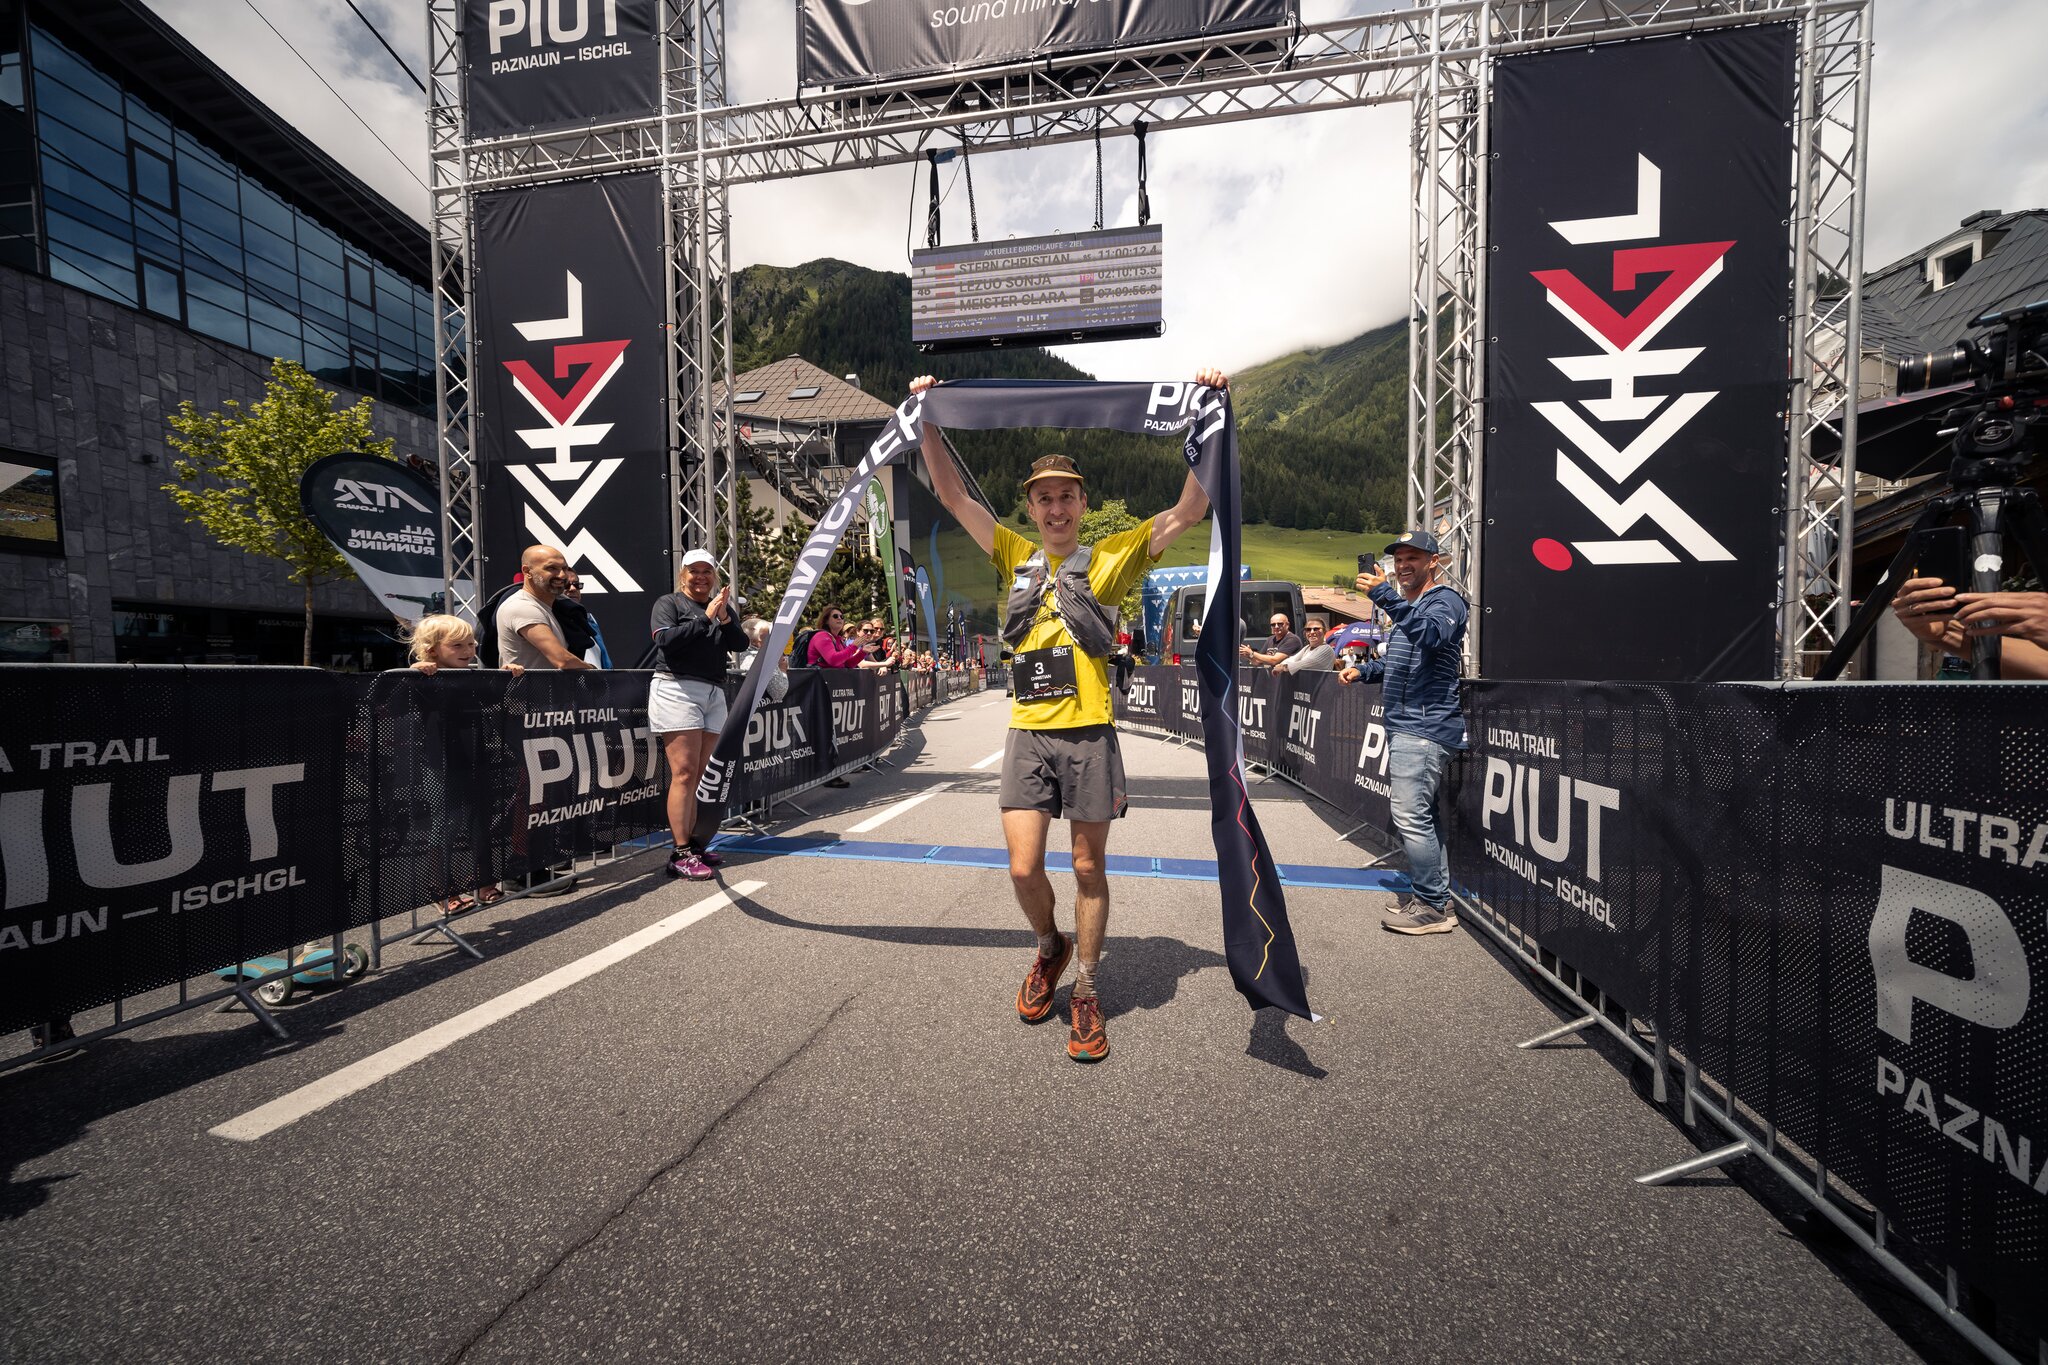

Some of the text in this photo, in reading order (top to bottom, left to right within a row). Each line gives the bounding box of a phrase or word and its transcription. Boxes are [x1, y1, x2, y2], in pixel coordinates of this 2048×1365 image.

[488, 0, 618, 55] PIUT
[930, 0, 1006, 28] sound
[491, 51, 561, 75] PAZNAUN
[578, 42, 632, 62] ISCHGL
[959, 259, 999, 273] STERN
[1002, 252, 1070, 269] CHRISTIAN
[1098, 244, 1158, 260] 11:00:124
[983, 246, 1018, 256] AKTUELLE
[1069, 240, 1084, 248] ZIEL
[959, 277, 1002, 293] LEZUO
[1005, 272, 1052, 289] SONJA
[959, 295, 1018, 312] MEISTER
[1021, 290, 1068, 306] CLARA
[1034, 661, 1045, 675] 3
[1127, 684, 1156, 707] PIUT
[1182, 687, 1200, 713] PIU
[1240, 695, 1267, 728] IUT
[1370, 704, 1384, 718] ULT
[523, 707, 618, 729] ULTRA TRAIL
[743, 705, 807, 757] PIUT
[832, 699, 866, 733] PIUT
[1288, 704, 1322, 749] PIUT
[30, 737, 170, 770] TRAIL
[743, 754, 784, 774] PAZNAUN
[790, 746, 816, 760] ISCHGL
[1357, 722, 1391, 776] PI
[1487, 727, 1561, 760] ULTRA TRAIL
[522, 726, 664, 806] PIUT
[695, 754, 725, 803] PIUT
[527, 797, 604, 830] PAZNAUN
[619, 783, 661, 806] ISCHGL
[1481, 756, 1621, 883] PIUT
[170, 865, 306, 915] ISCHGL
[1484, 838, 1538, 886] PAZNAUN
[1556, 876, 1616, 930] ISCHGL
